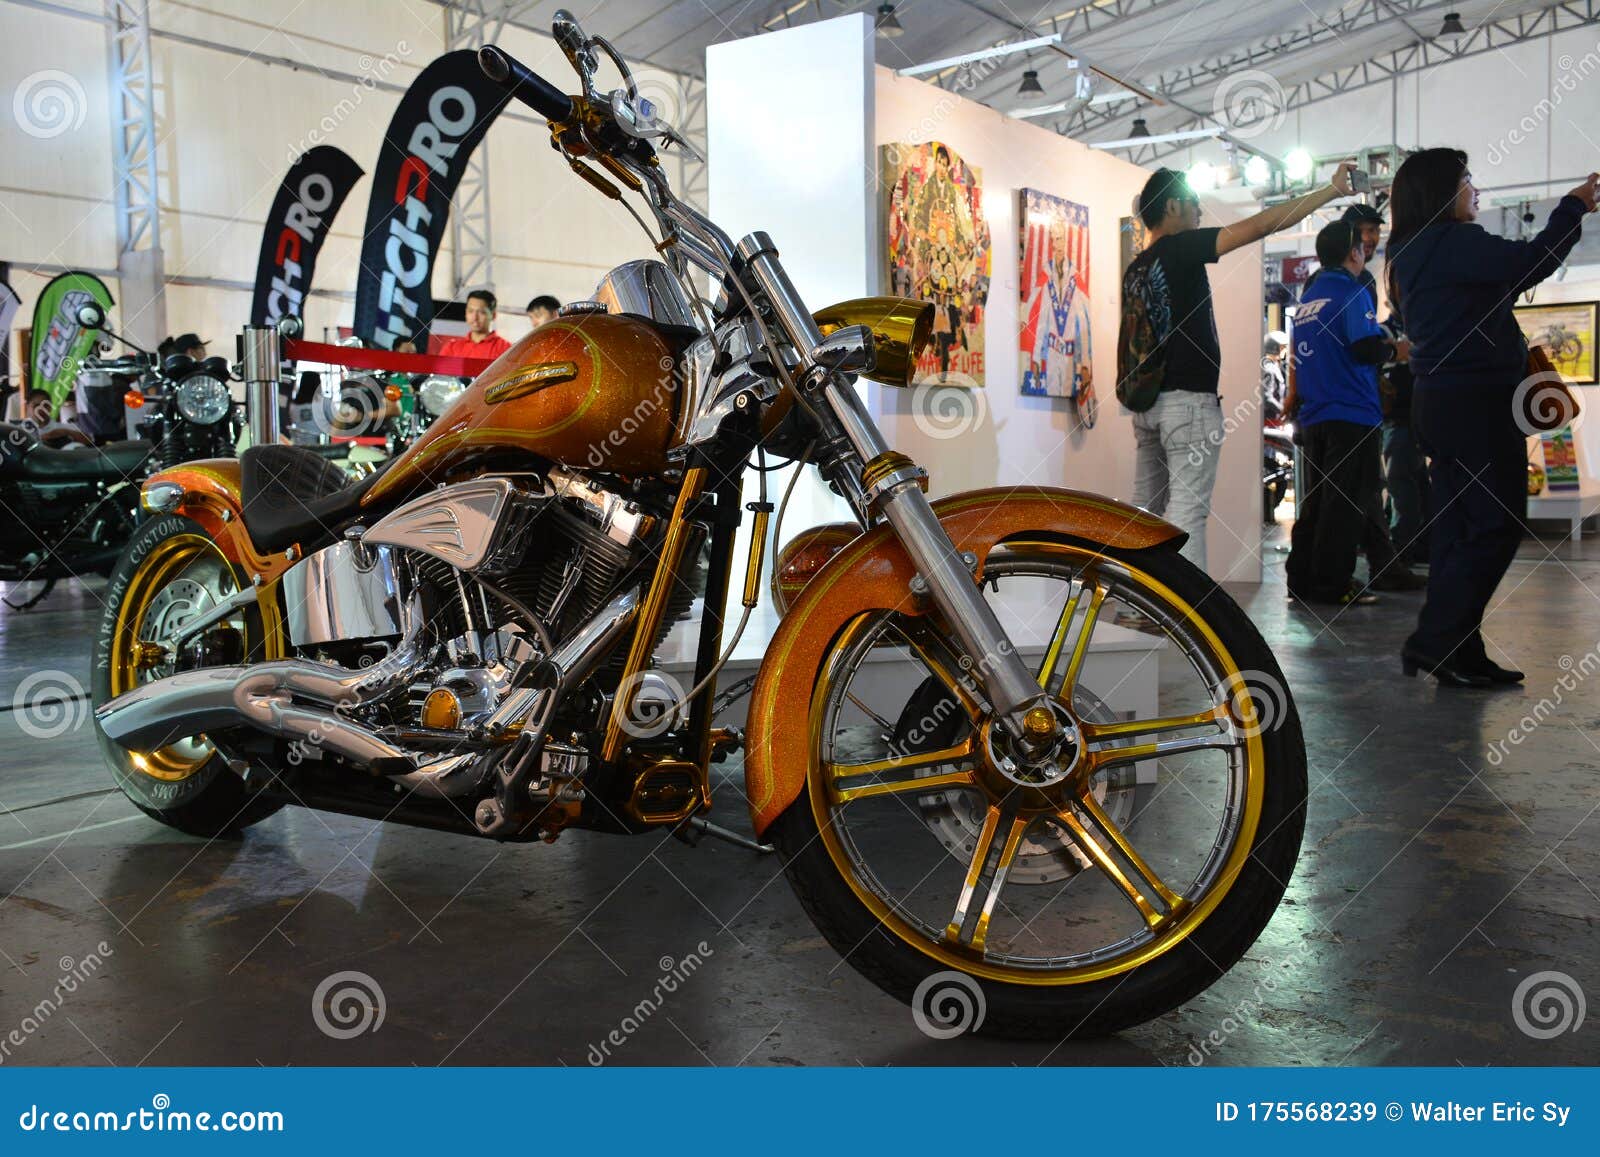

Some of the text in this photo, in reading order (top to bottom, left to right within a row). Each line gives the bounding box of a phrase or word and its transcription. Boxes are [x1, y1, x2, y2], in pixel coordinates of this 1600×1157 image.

[961, 351, 984, 375] LIFE
[97, 518, 185, 670] MARFORI CUSTOMS
